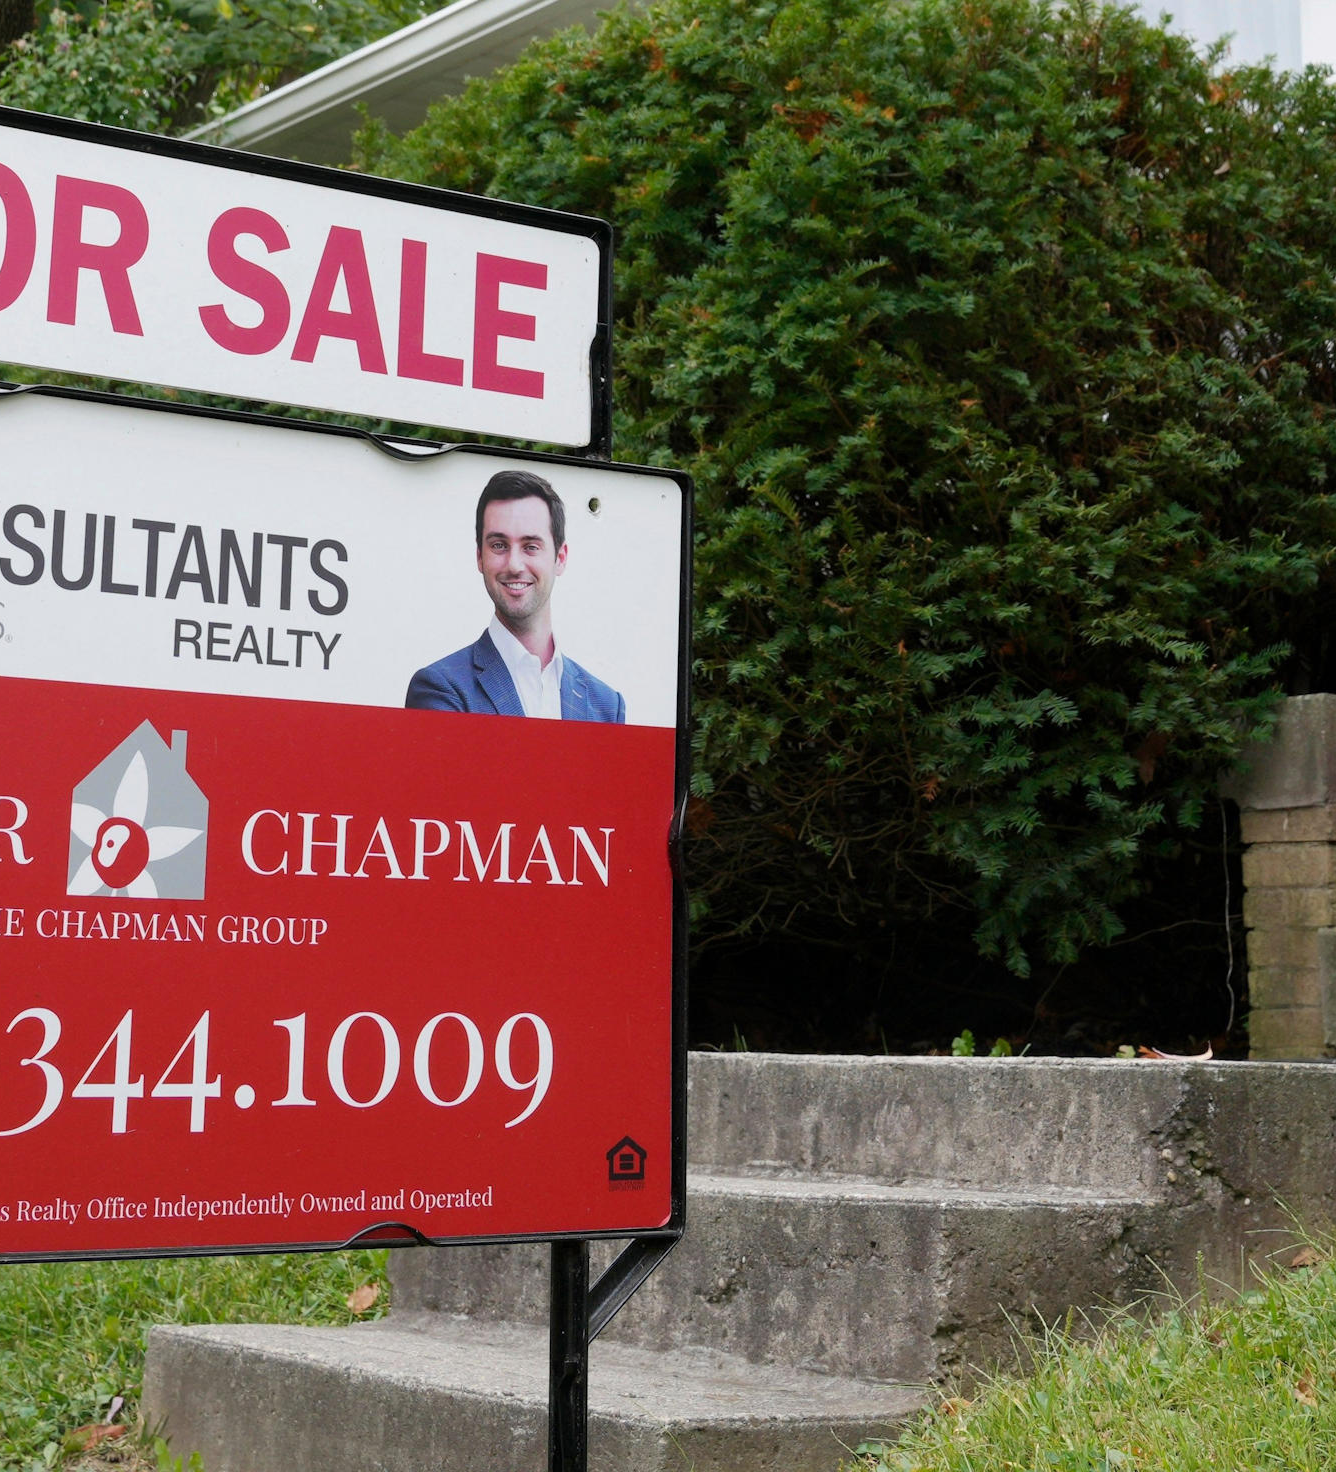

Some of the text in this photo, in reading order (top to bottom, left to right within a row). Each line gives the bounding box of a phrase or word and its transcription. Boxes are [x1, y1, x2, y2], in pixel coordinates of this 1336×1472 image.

[198, 206, 548, 400] SALE
[172, 618, 342, 670] REALTY
[239, 808, 615, 889] CHAPMAN
[36, 909, 208, 943] CHAPMAN
[216, 915, 328, 946] GROUP
[16, 1197, 81, 1225] Realty
[86, 1196, 148, 1220] Office
[153, 1191, 295, 1221] Independently
[300, 1190, 366, 1214] Owned
[371, 1188, 405, 1211] and
[410, 1185, 494, 1214] Operated
